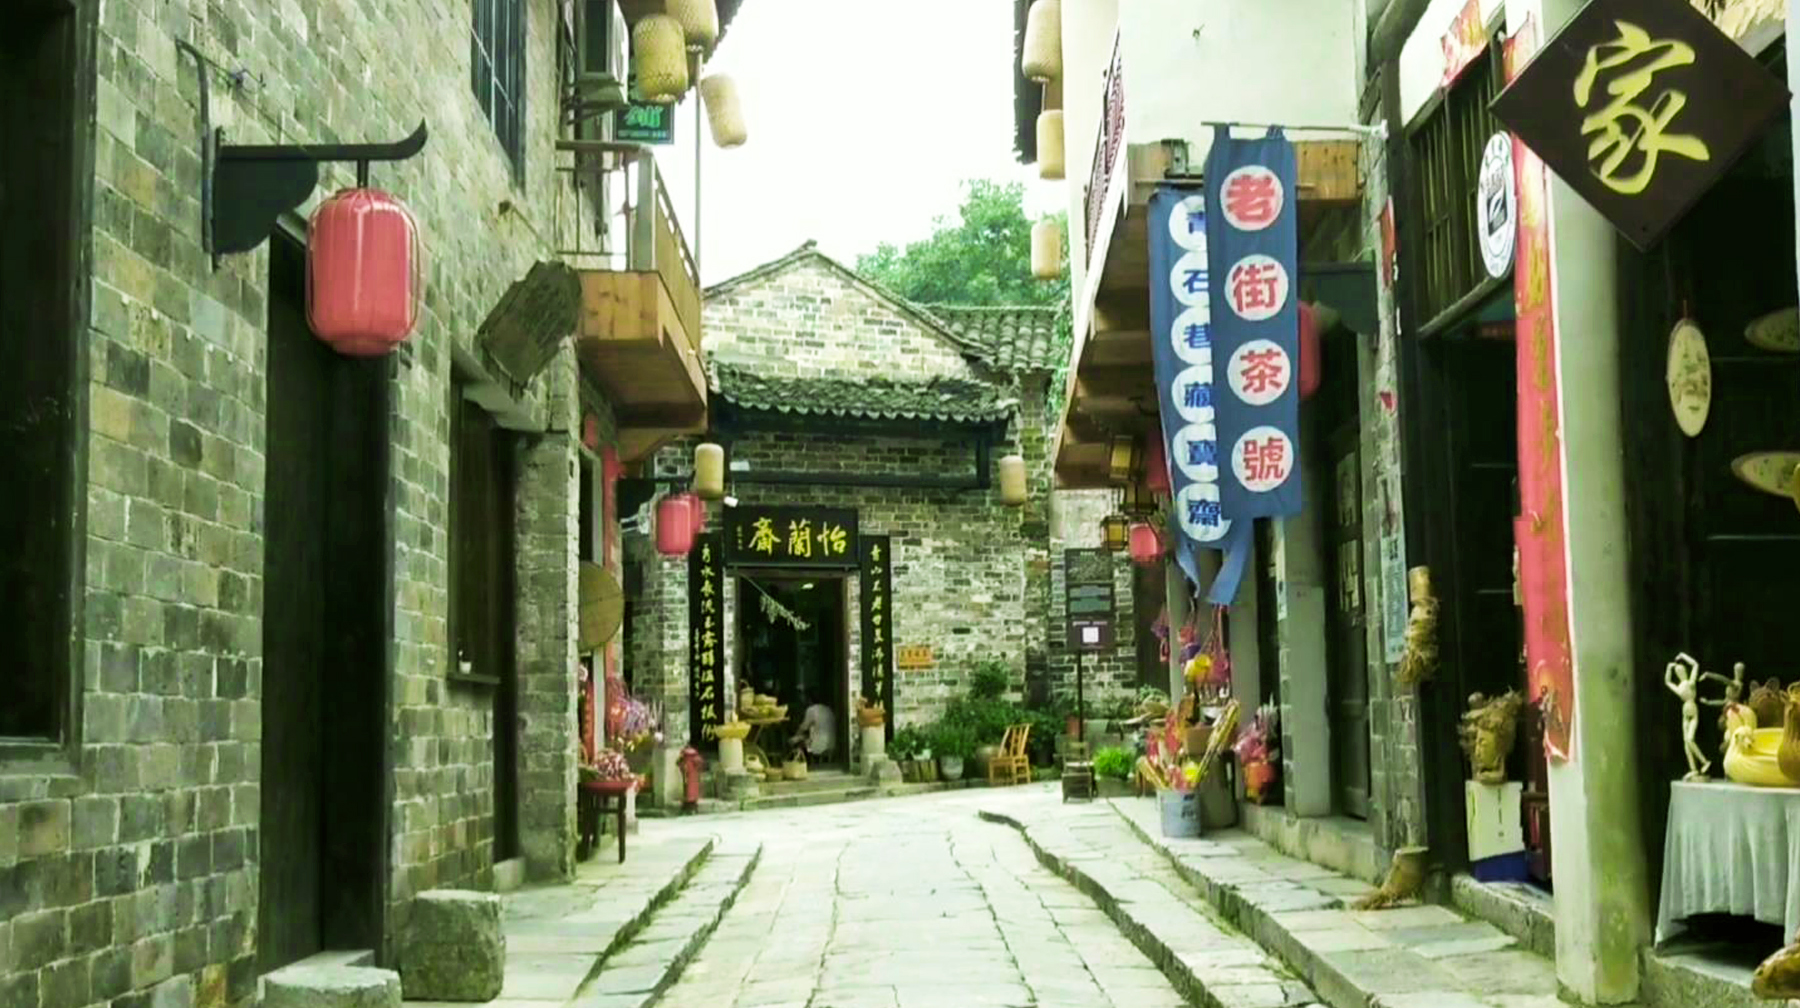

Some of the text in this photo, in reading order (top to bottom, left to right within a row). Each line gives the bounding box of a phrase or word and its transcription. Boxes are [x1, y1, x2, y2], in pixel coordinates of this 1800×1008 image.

[1573, 20, 1710, 195] 家
[1226, 174, 1284, 482] 老街茶號
[748, 516, 848, 558] 怡蘭齋
